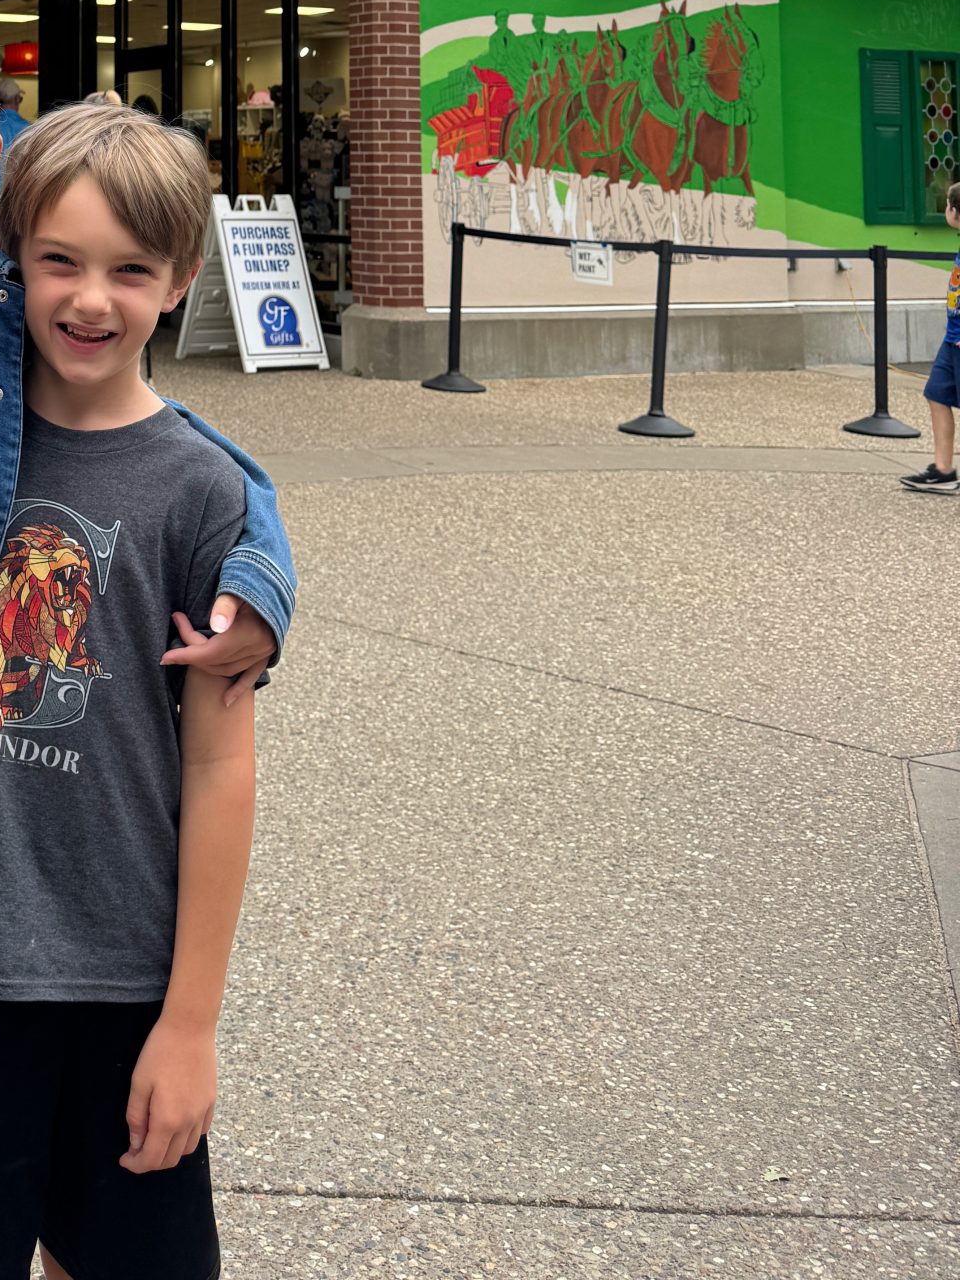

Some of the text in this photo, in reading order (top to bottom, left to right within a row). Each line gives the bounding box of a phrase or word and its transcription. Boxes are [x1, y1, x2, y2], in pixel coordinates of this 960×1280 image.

[231, 226, 291, 239] PURCHASE
[233, 243, 296, 256] A FUN PASS
[244, 259, 290, 273] ONLINE?
[242, 281, 271, 291] REDEEM
[270, 332, 295, 345] Gifts
